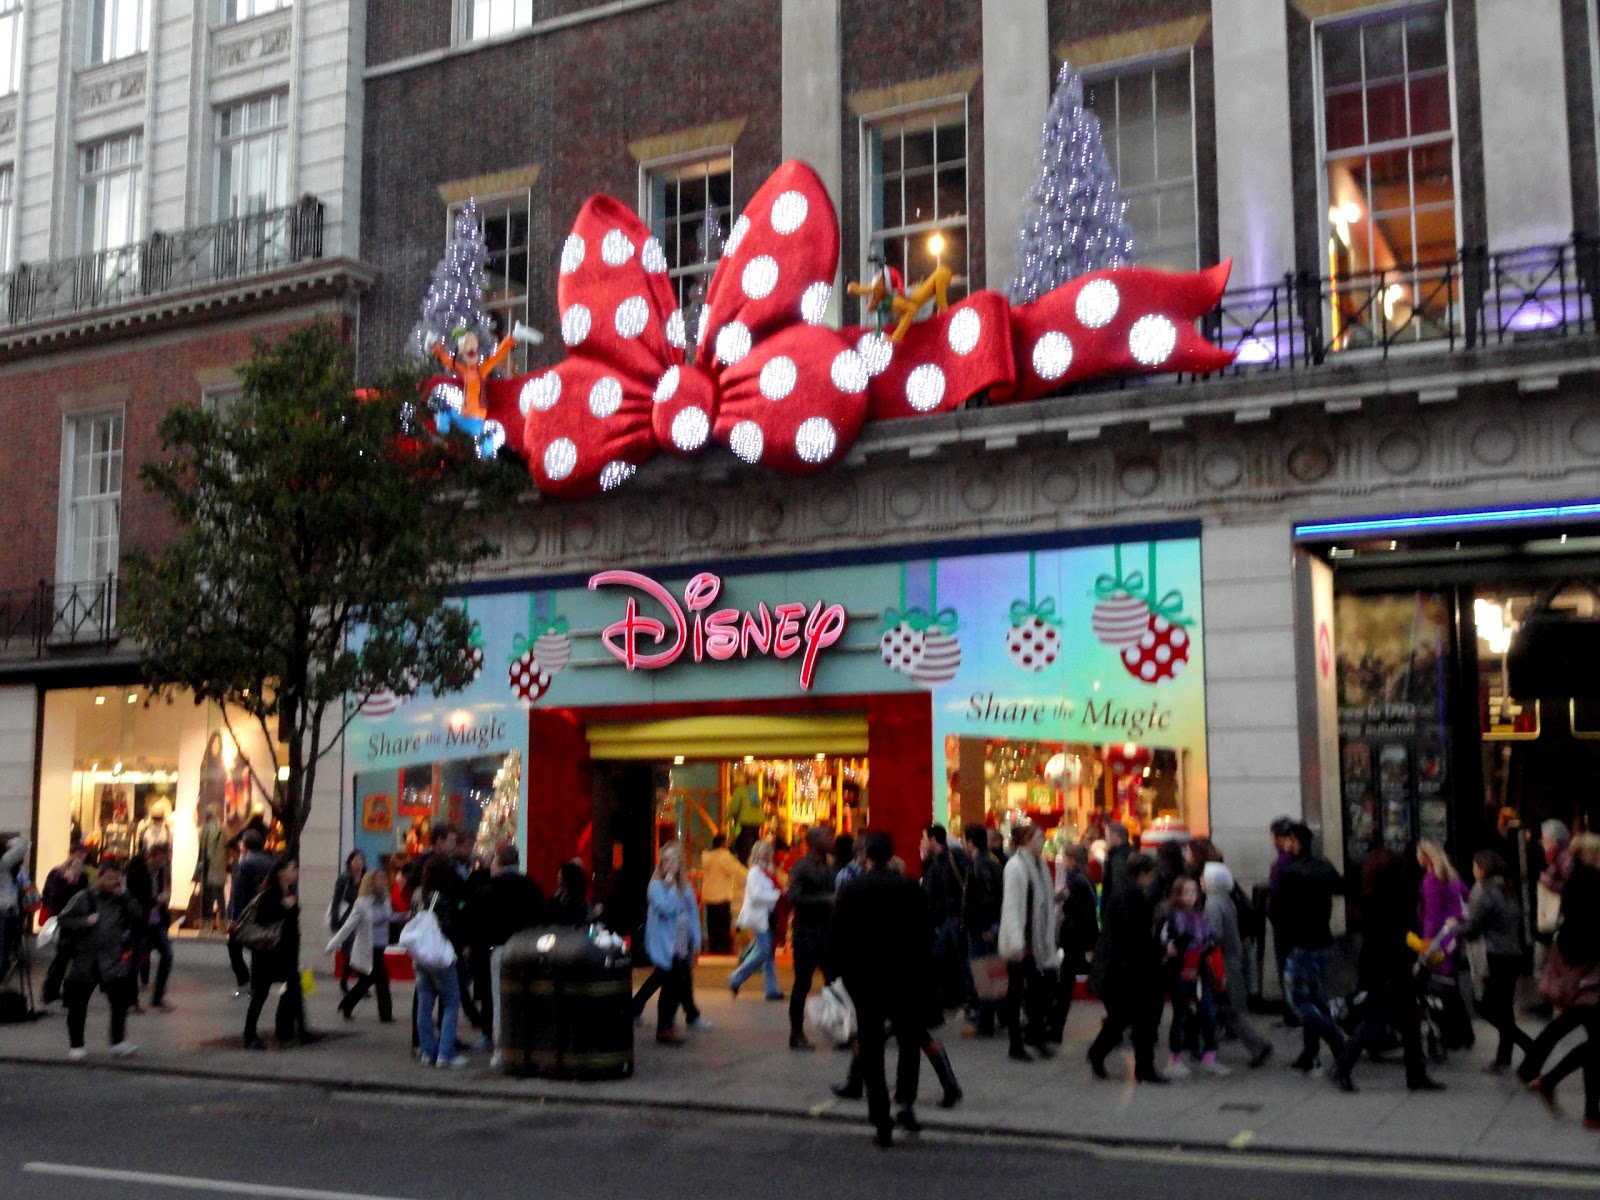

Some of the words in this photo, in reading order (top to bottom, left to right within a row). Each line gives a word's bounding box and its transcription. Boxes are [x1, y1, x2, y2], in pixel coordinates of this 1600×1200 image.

[588, 570, 846, 691] Disney
[366, 731, 422, 762] Share
[445, 714, 507, 751] Magic
[966, 690, 1047, 725] Share
[1052, 699, 1077, 721] the
[1082, 696, 1173, 739] Magic
